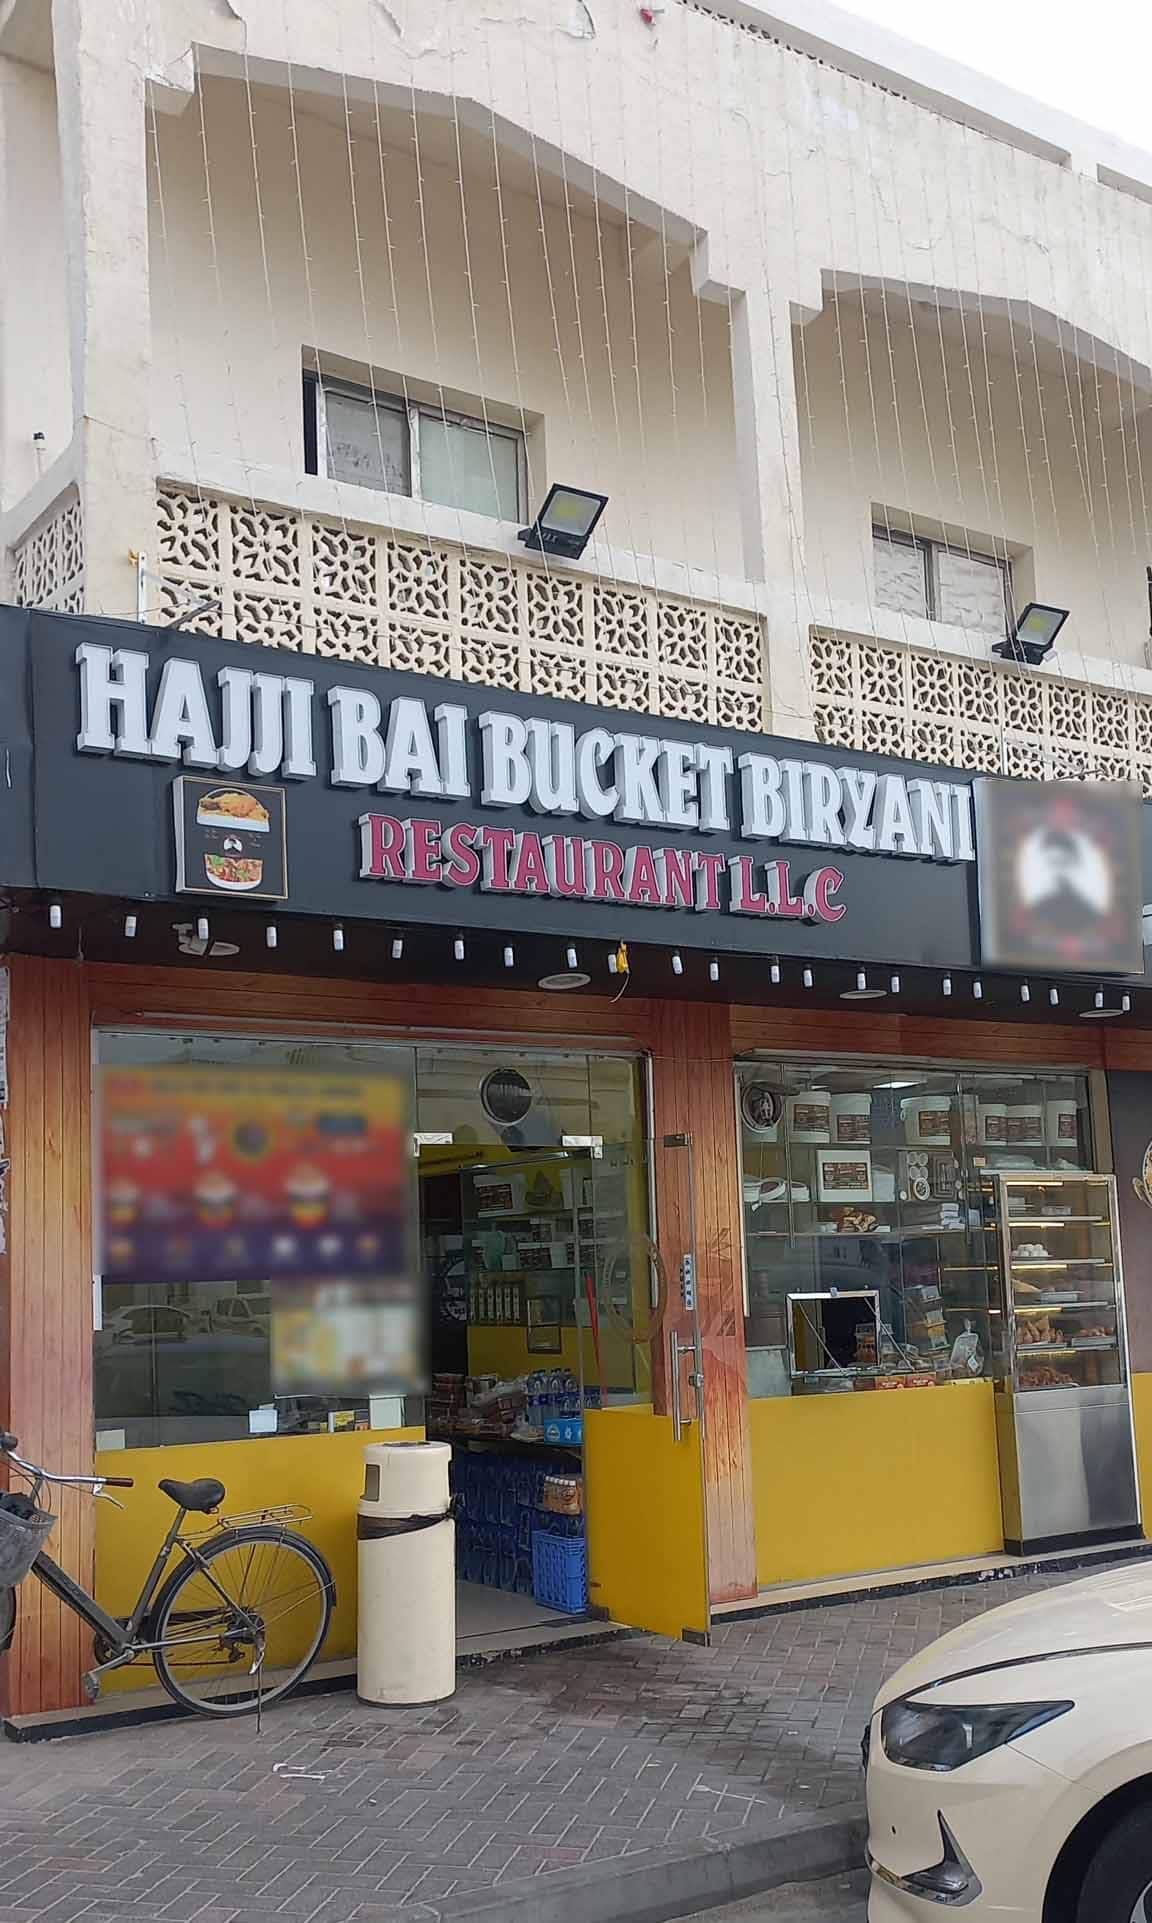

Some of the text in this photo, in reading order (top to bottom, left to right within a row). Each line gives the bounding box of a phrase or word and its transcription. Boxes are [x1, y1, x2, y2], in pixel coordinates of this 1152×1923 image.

[75, 641, 976, 862] HAJJI BAI BUCKET BIRYANI
[358, 812, 726, 911] RESTAURANT
